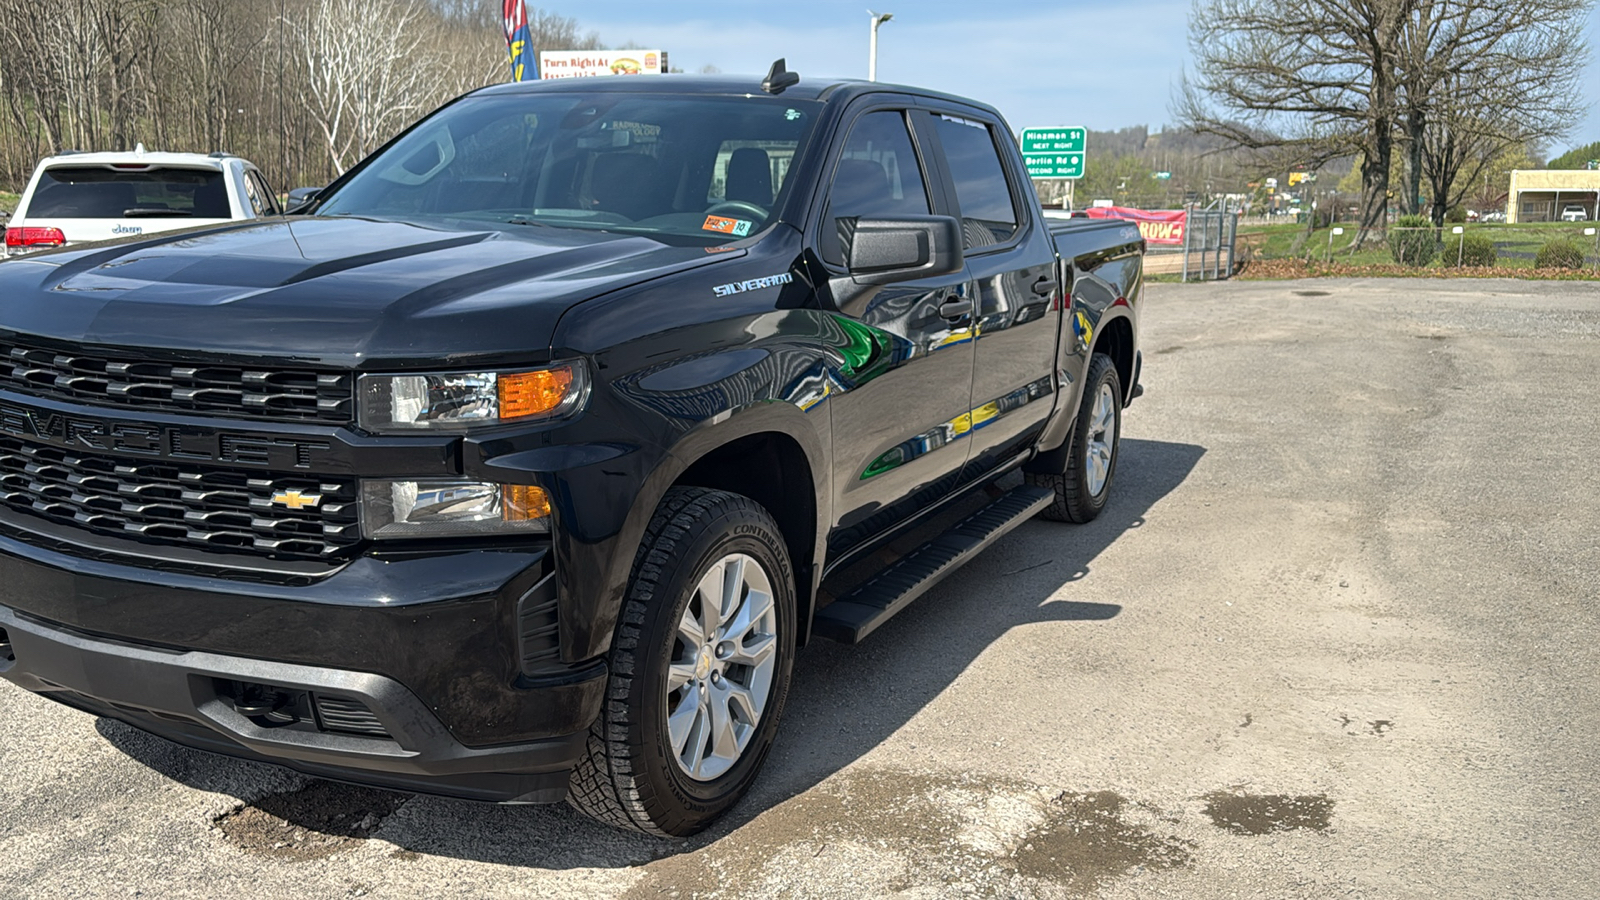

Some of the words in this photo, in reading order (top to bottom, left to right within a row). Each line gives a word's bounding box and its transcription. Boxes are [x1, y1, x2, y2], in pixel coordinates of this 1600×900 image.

[544, 59, 567, 68] Turn
[571, 57, 596, 69] Right
[598, 58, 608, 67] At
[1070, 131, 1081, 140] St
[1025, 156, 1053, 165] Berlin
[1056, 156, 1068, 165] Rd
[1027, 167, 1053, 175] SECOND
[713, 272, 793, 298] SILVERADO
[734, 524, 791, 584] CONTINENTAL
